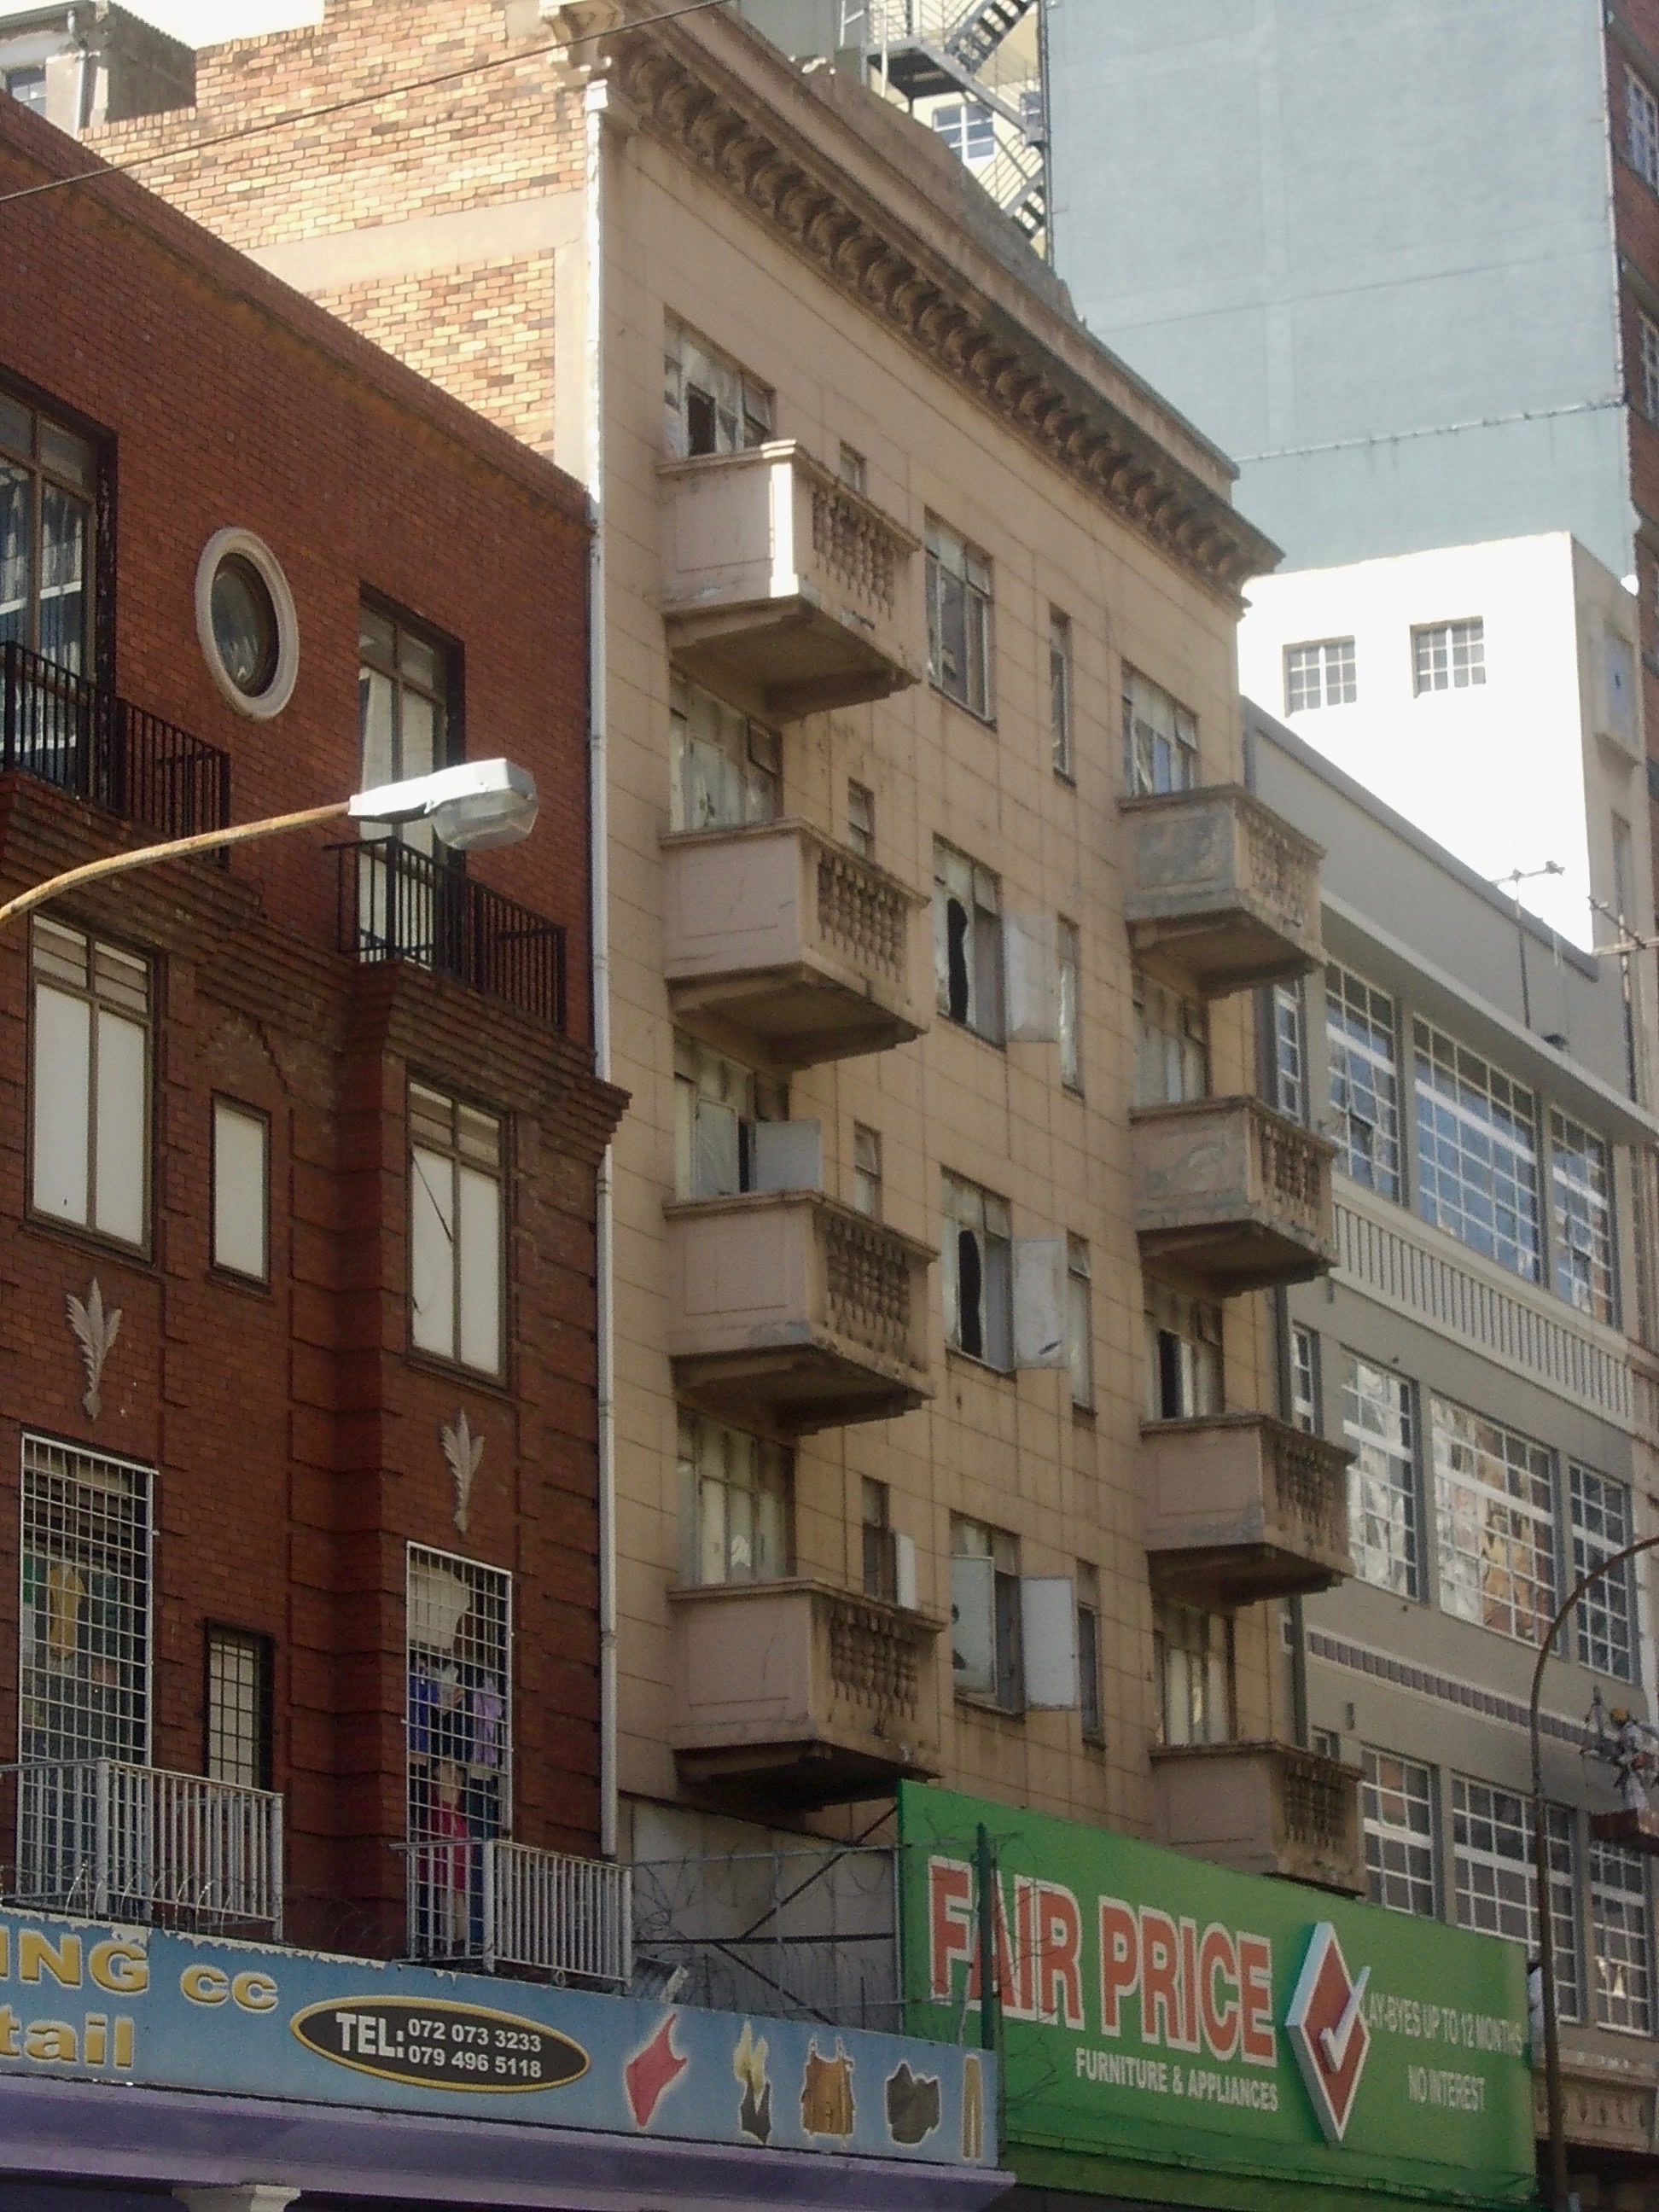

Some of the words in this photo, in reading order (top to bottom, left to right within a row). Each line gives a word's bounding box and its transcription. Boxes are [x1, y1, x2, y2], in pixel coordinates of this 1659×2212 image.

[928, 1855, 1085, 2031] FAIR
[1098, 1895, 1278, 2068] PRICE
[0, 2003, 135, 2069] tail
[335, 2011, 405, 2058] TEL:
[408, 2018, 445, 2040] 072
[451, 2024, 489, 2046] 073
[494, 2029, 542, 2052] 3233
[1423, 2004, 1441, 2039] UP
[1441, 2007, 1458, 2045] TO
[1461, 2012, 1475, 2048] 12
[1476, 2014, 1524, 2058] MONTHS
[408, 2045, 445, 2066] 079
[451, 2051, 489, 2072] 496
[494, 2056, 542, 2078] 5118
[1075, 2046, 1168, 2093] FURNITURE
[1173, 2067, 1184, 2095] &
[1187, 2071, 1278, 2112] APPLIANCES
[1408, 2064, 1428, 2104] NO
[1429, 2069, 1486, 2112] INTEREST
